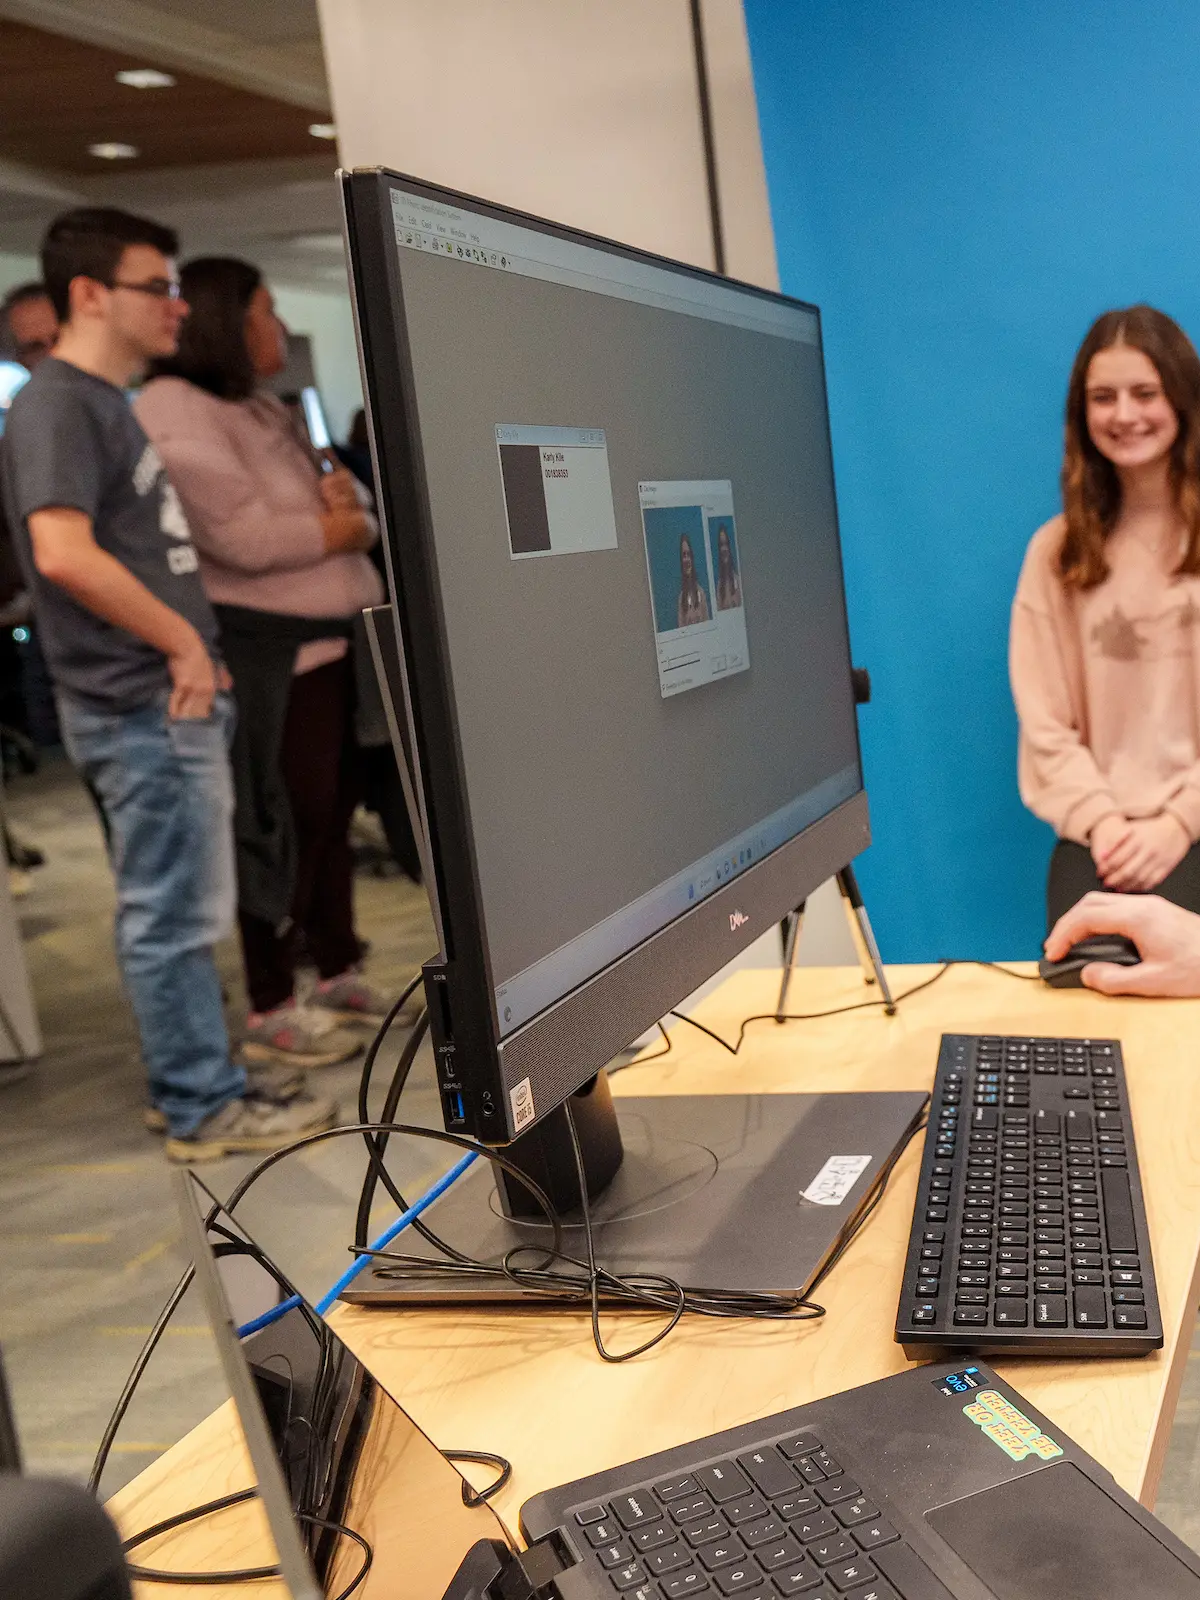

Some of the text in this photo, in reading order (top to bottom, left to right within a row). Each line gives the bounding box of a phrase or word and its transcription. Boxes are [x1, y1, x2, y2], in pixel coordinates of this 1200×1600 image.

[946, 1375, 967, 1392] evo
[967, 1403, 1031, 1457] YEET OR
[979, 1391, 1060, 1457] BE YEETED
[774, 1548, 785, 1558] L
[715, 1549, 744, 1580] O P
[844, 1566, 858, 1578] M
[790, 1572, 804, 1582] K
